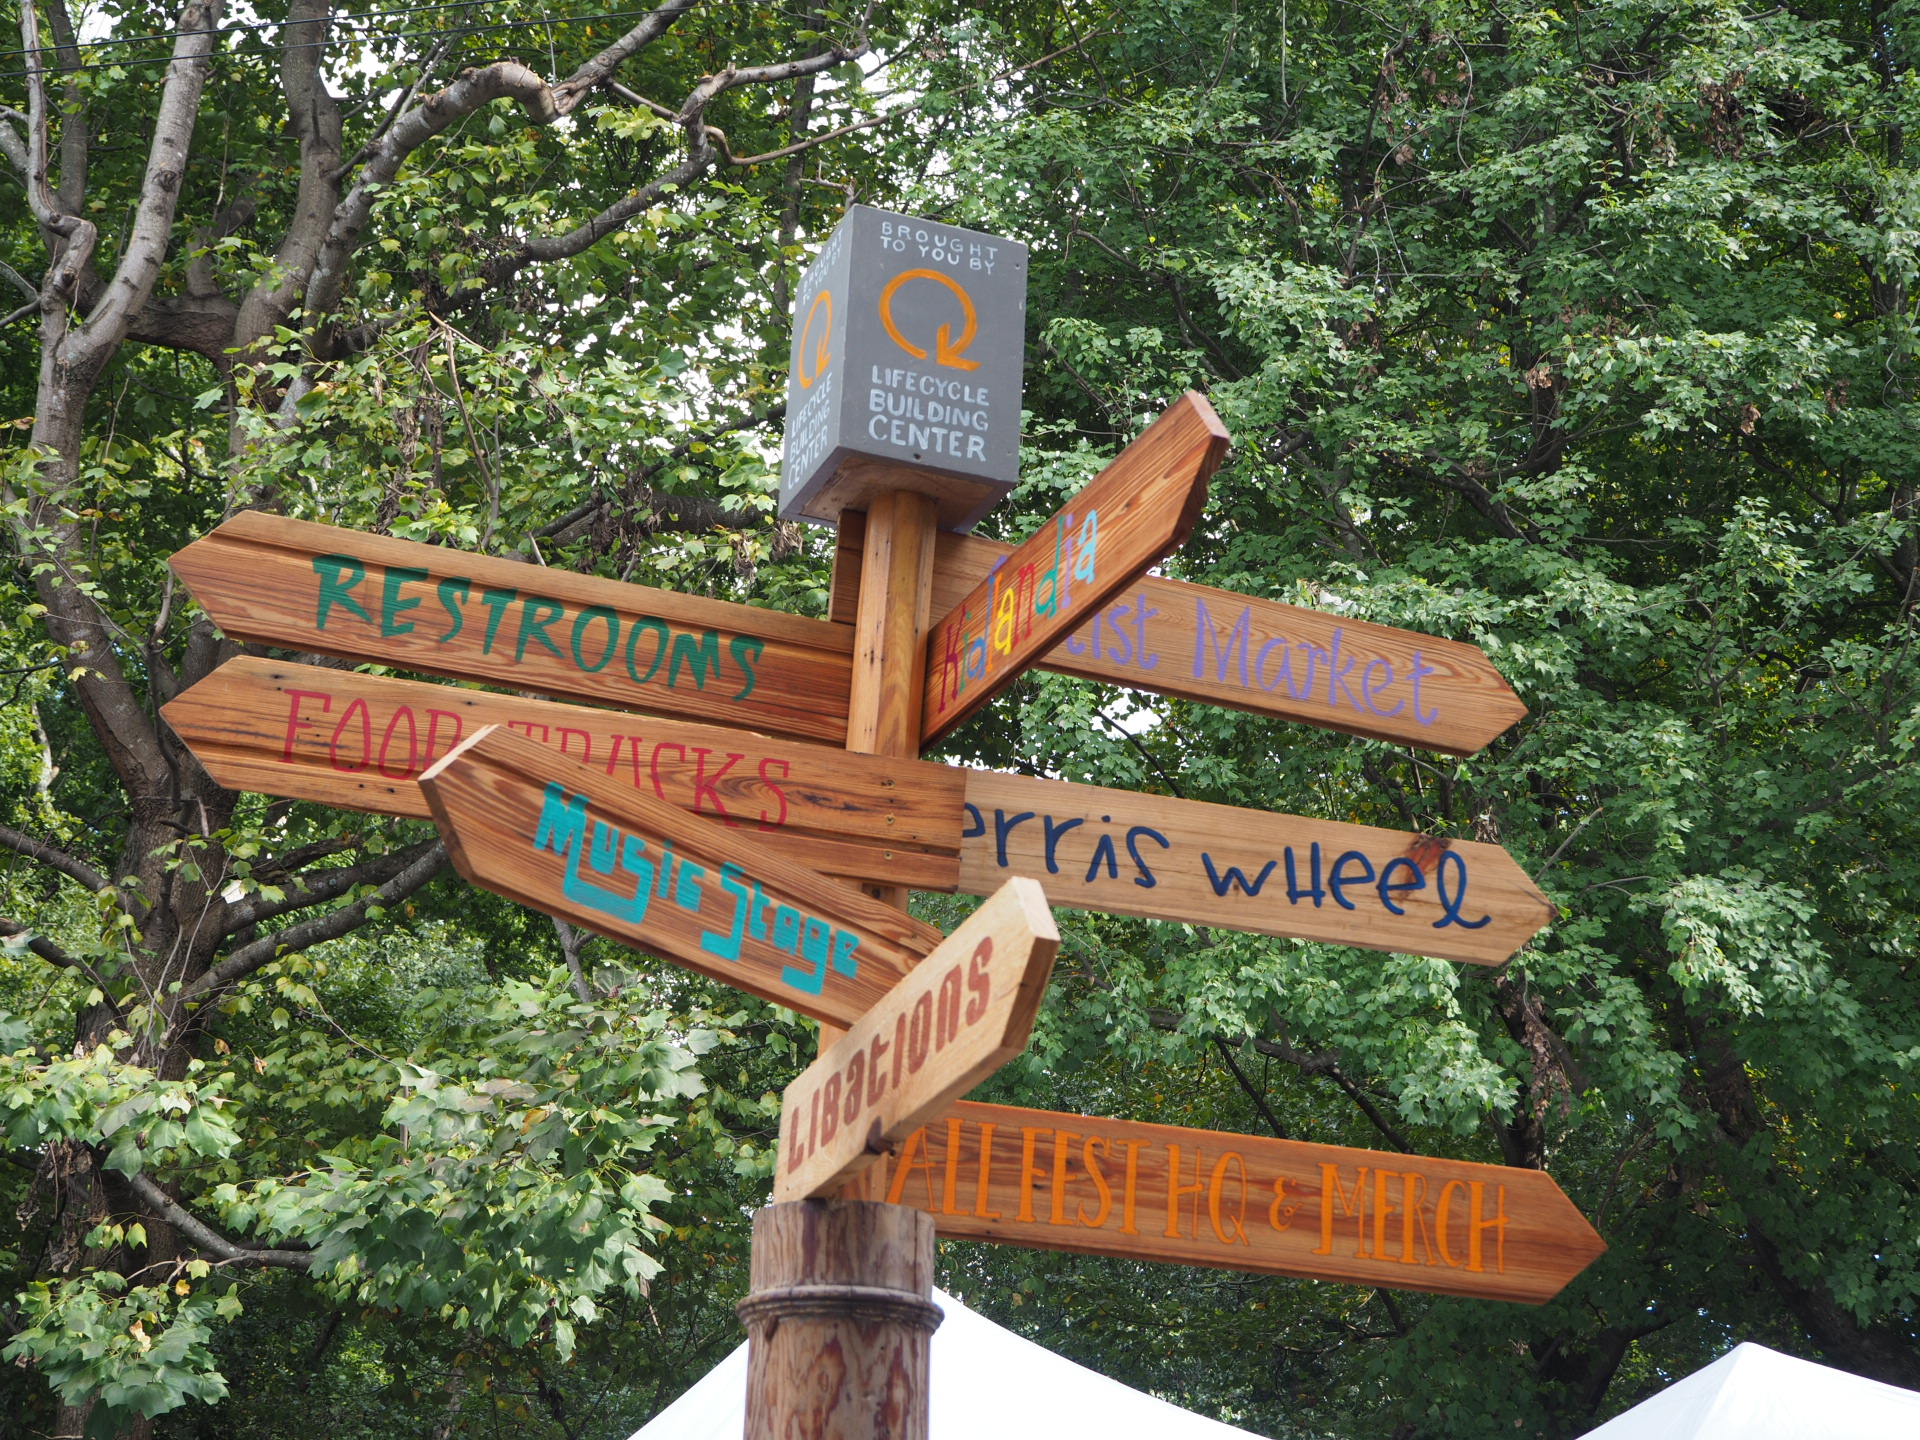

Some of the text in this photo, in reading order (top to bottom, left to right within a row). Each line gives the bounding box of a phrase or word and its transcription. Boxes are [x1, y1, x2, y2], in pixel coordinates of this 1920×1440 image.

[803, 228, 843, 293] BROUGHT
[880, 235, 995, 275] TO YOU BY
[881, 221, 999, 260] BROUGHT
[791, 371, 832, 438] LIFECYCLE
[869, 388, 989, 432] BUILDING
[872, 365, 989, 406] LIFECYCLE
[787, 425, 828, 490] CENTER
[790, 399, 830, 464] BUILDING
[868, 414, 987, 462] CENTER
[311, 553, 765, 701] RESTROOMS
[938, 509, 1098, 713] Kidlandia
[1192, 597, 1439, 726] Market
[533, 781, 860, 996] Music Stage
[886, 1117, 1510, 1275] ALL FEST HQ & MERCH
